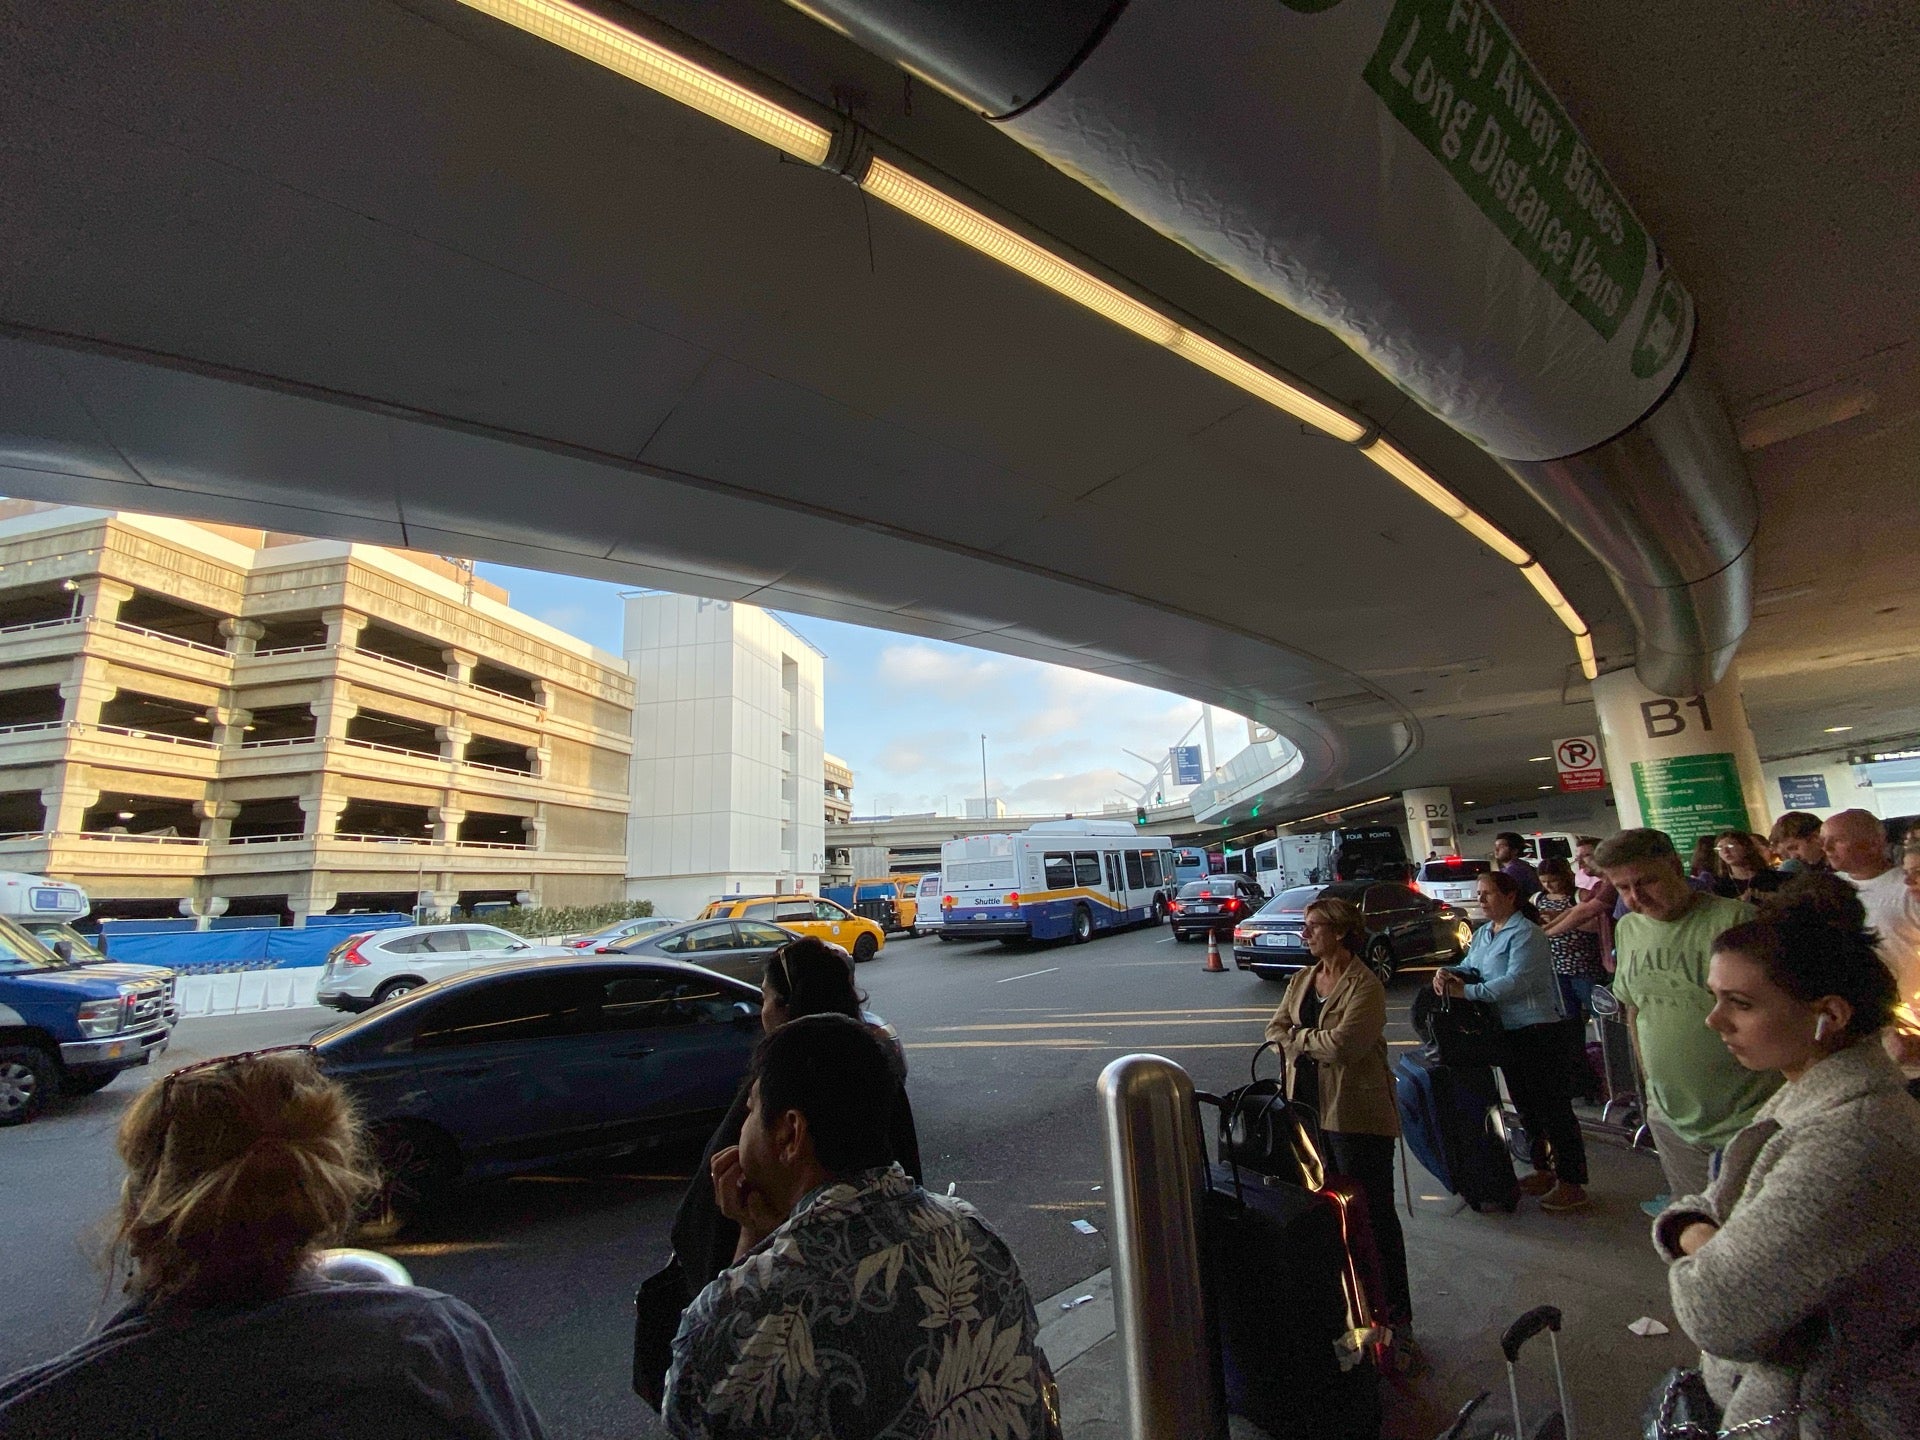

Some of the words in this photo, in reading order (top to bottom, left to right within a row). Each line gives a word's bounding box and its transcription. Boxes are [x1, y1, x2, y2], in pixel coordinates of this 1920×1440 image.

[1389, 14, 1477, 161] Long
[1469, 114, 1571, 265] Distance
[1570, 236, 1624, 317] Vans
[1564, 142, 1624, 245] Buses
[1640, 693, 1713, 738] B1
[1565, 777, 1601, 785] Tow-Away
[1425, 804, 1449, 818] B2
[1648, 805, 1693, 815] Scheduled
[812, 853, 824, 871] P3
[974, 898, 1001, 906] Shuttle
